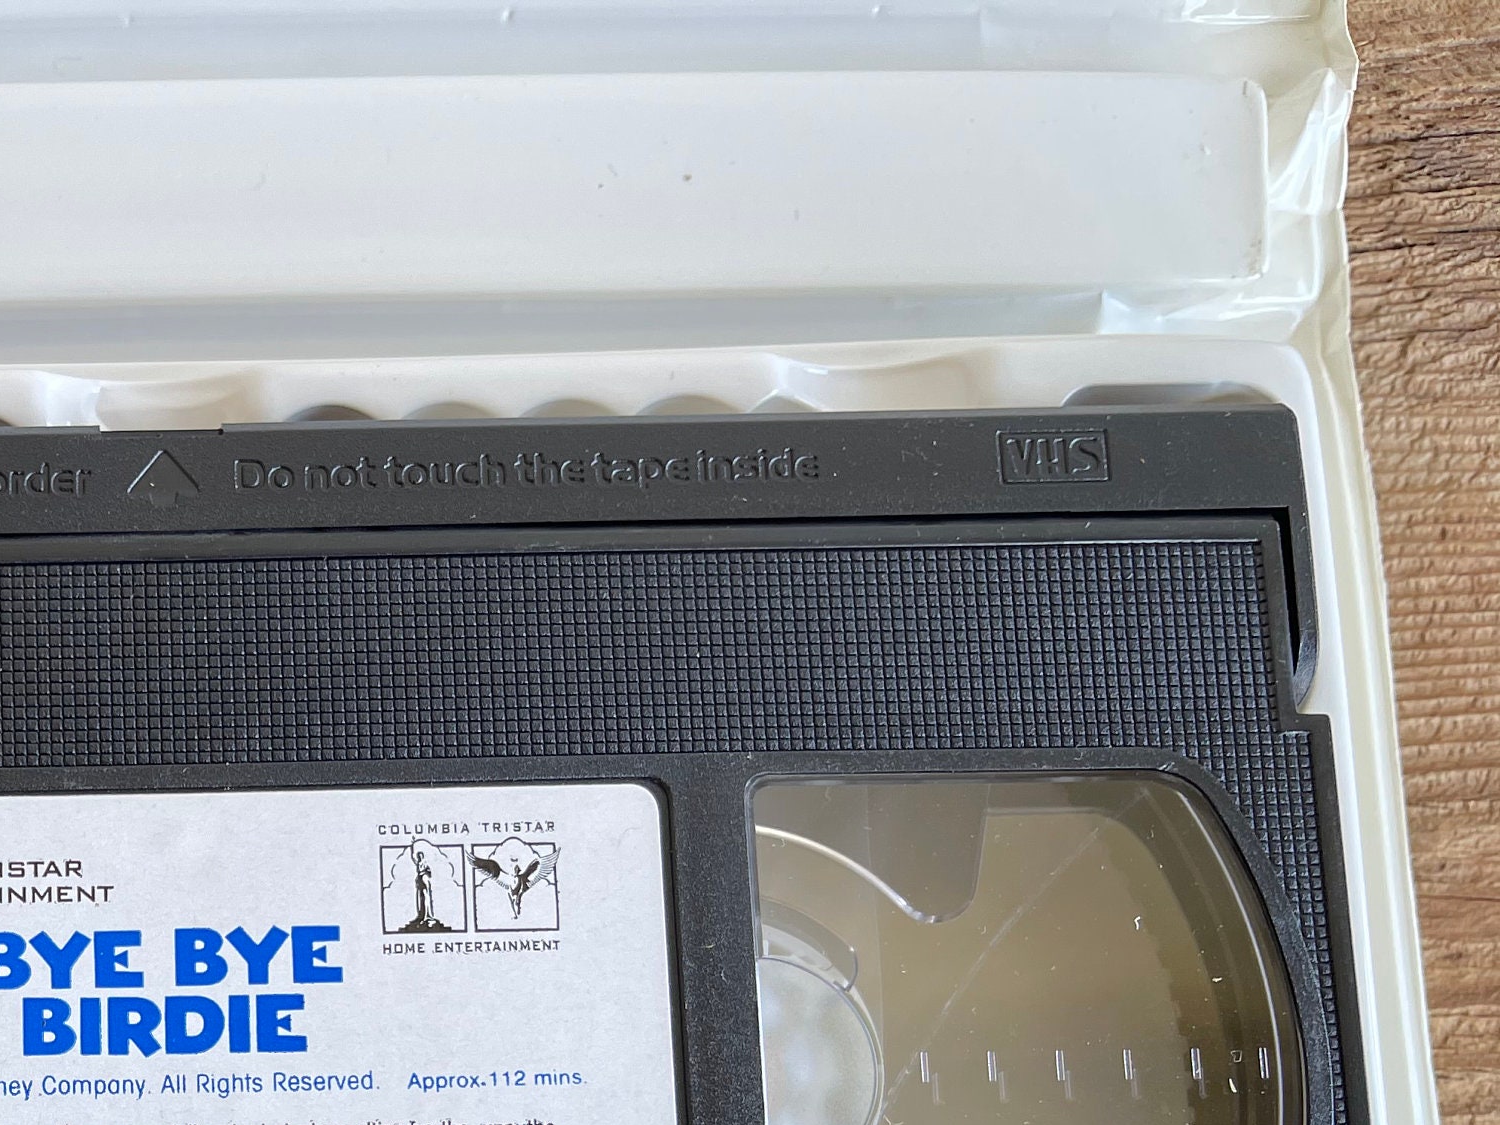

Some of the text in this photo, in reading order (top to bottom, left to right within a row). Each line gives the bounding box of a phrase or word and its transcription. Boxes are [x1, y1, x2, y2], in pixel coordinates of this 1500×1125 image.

[233, 447, 819, 490] Do not touch the tape inside
[1006, 437, 1100, 476] VHS
[378, 820, 554, 835] COLUMBIA TRISTAR
[174, 925, 343, 987] BYE
[383, 939, 560, 955] HOME ENTERTAINMENT
[22, 993, 308, 1058] BIRDIE
[42, 1075, 151, 1100] Company.
[161, 1074, 186, 1094] All
[197, 1073, 263, 1099] Rights
[273, 1070, 379, 1092] Reserved.
[534, 1069, 588, 1086] mins.
